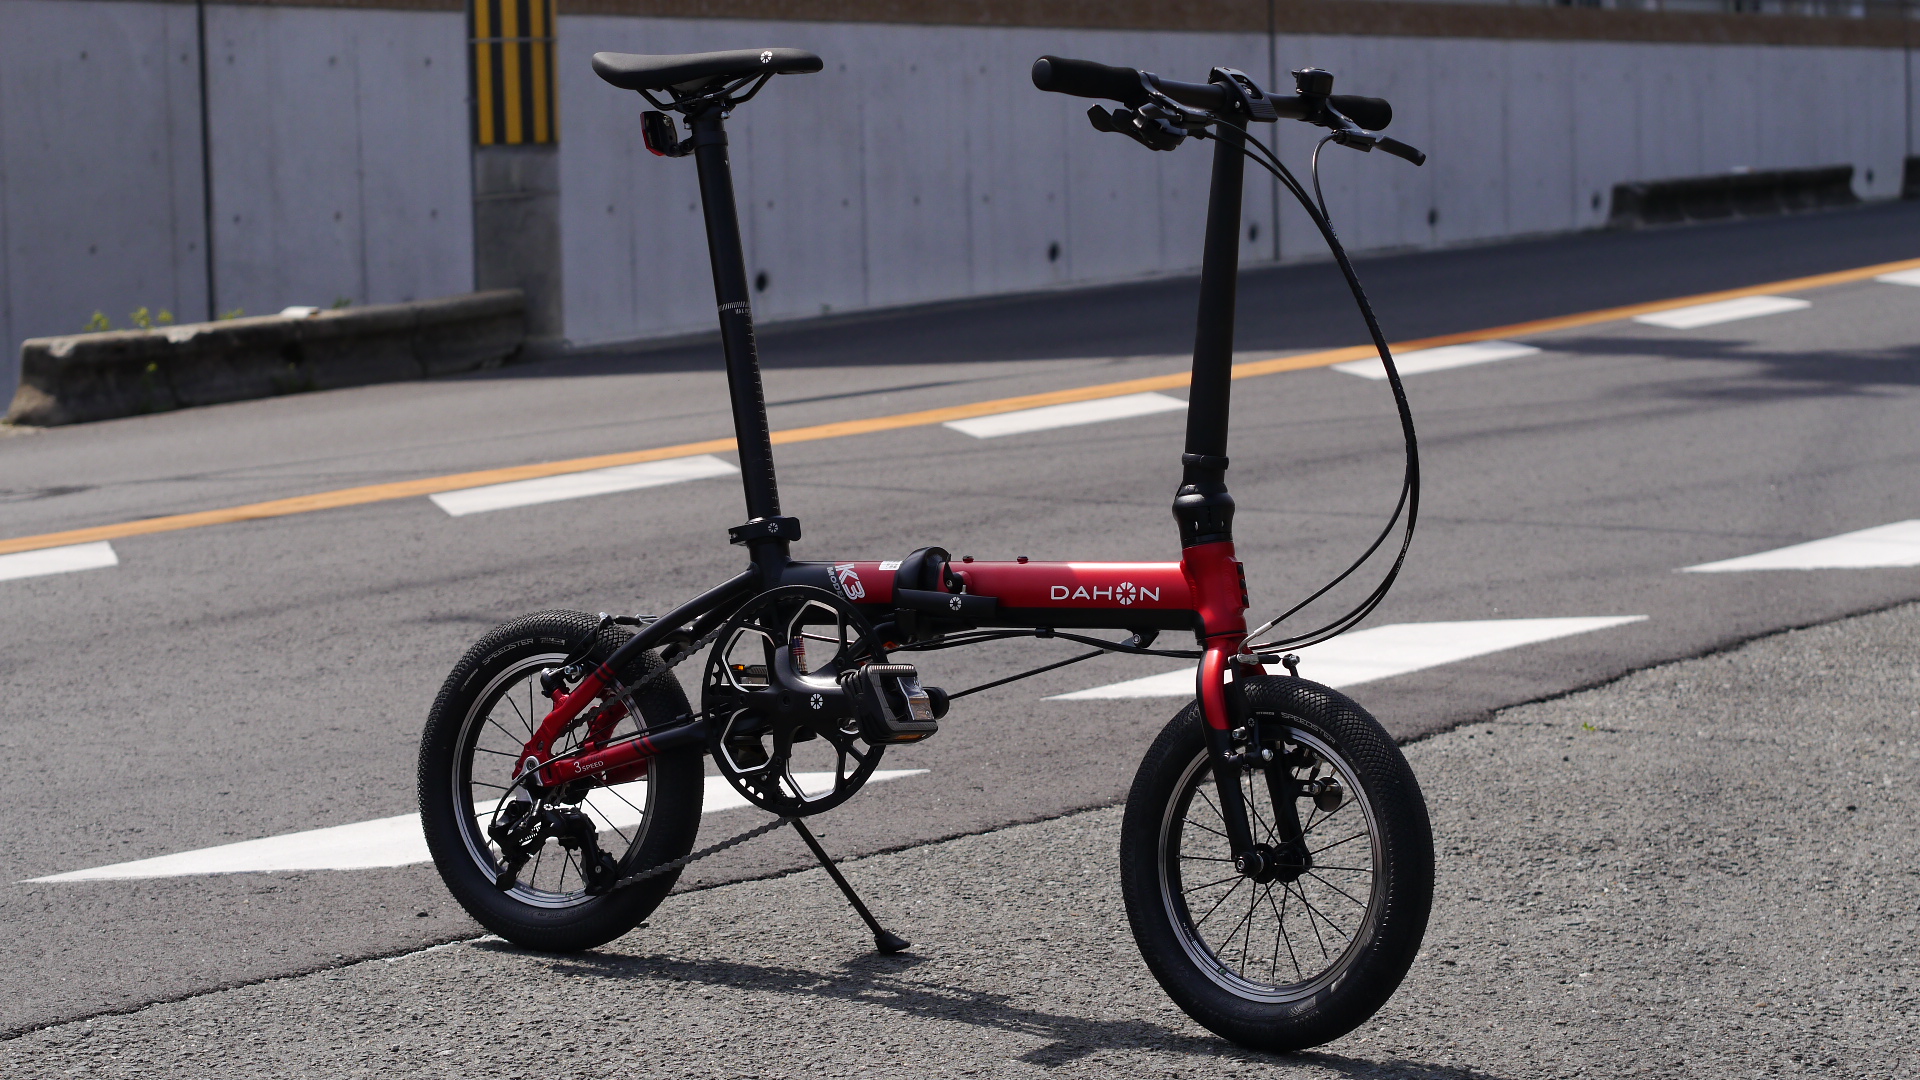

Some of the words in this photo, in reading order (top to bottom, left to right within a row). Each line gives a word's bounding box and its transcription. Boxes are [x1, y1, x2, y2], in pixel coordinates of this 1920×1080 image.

[834, 563, 866, 600] K3
[1050, 581, 1160, 606] DAHON
[481, 638, 534, 666] SPEEDSTER
[1280, 711, 1336, 745] SPEEDSTER
